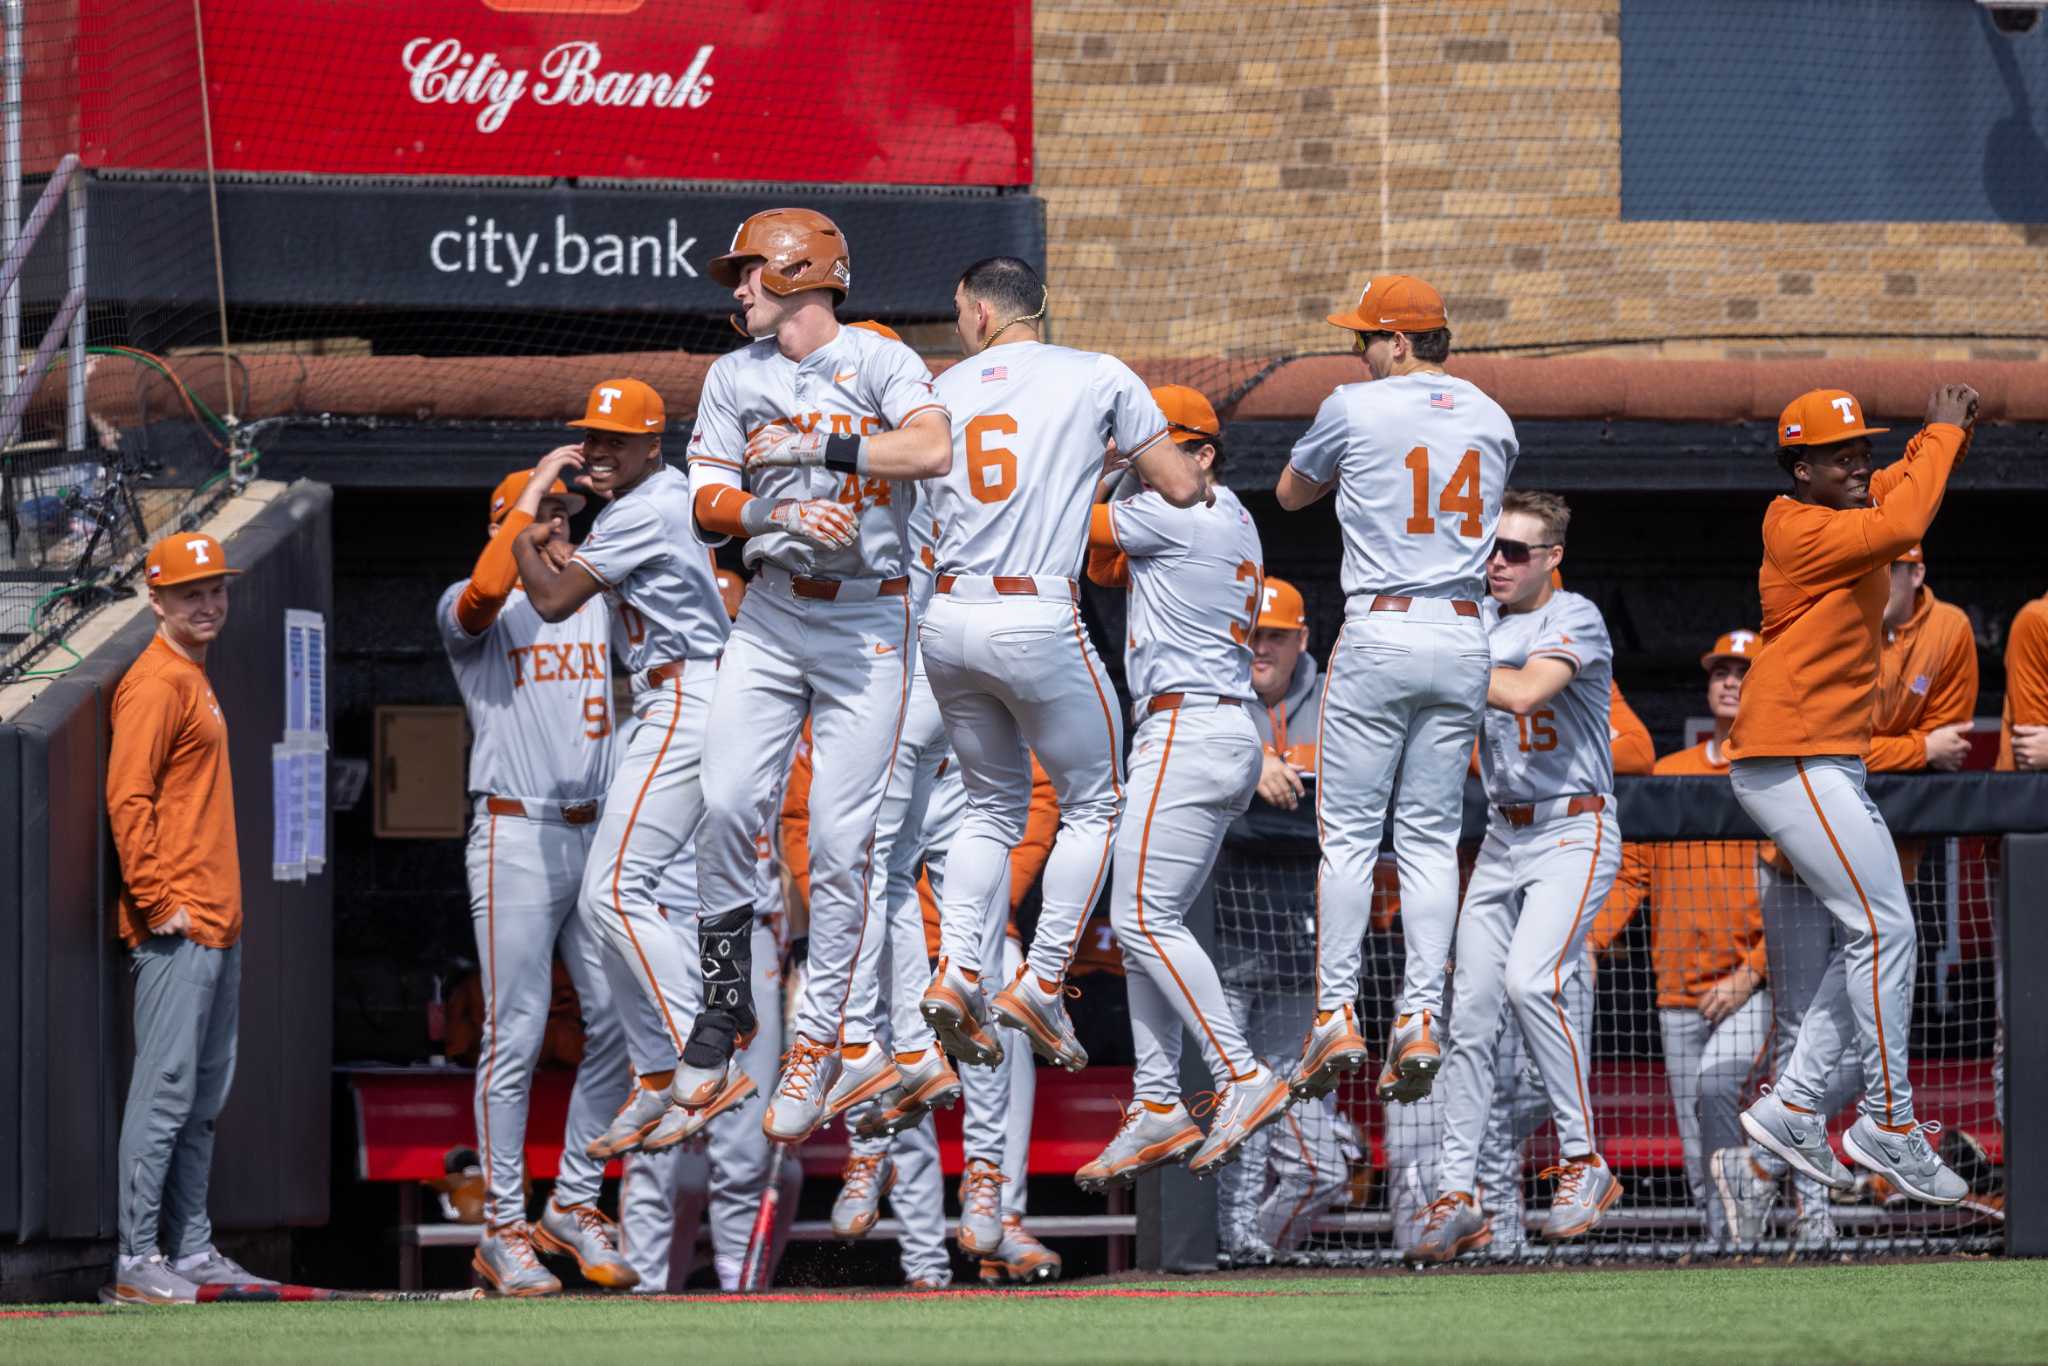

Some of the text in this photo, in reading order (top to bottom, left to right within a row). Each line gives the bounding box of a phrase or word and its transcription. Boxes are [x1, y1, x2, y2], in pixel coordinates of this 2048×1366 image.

[402, 37, 715, 133] City Bank
[429, 215, 699, 287] city.bank
[598, 387, 622, 414] T
[1831, 397, 1856, 424] T
[964, 414, 1019, 504] 6
[1404, 446, 1485, 538] 14
[186, 539, 210, 565] T
[507, 642, 608, 688] TEXA
[583, 695, 612, 740] 9
[1514, 709, 1558, 753] 15
